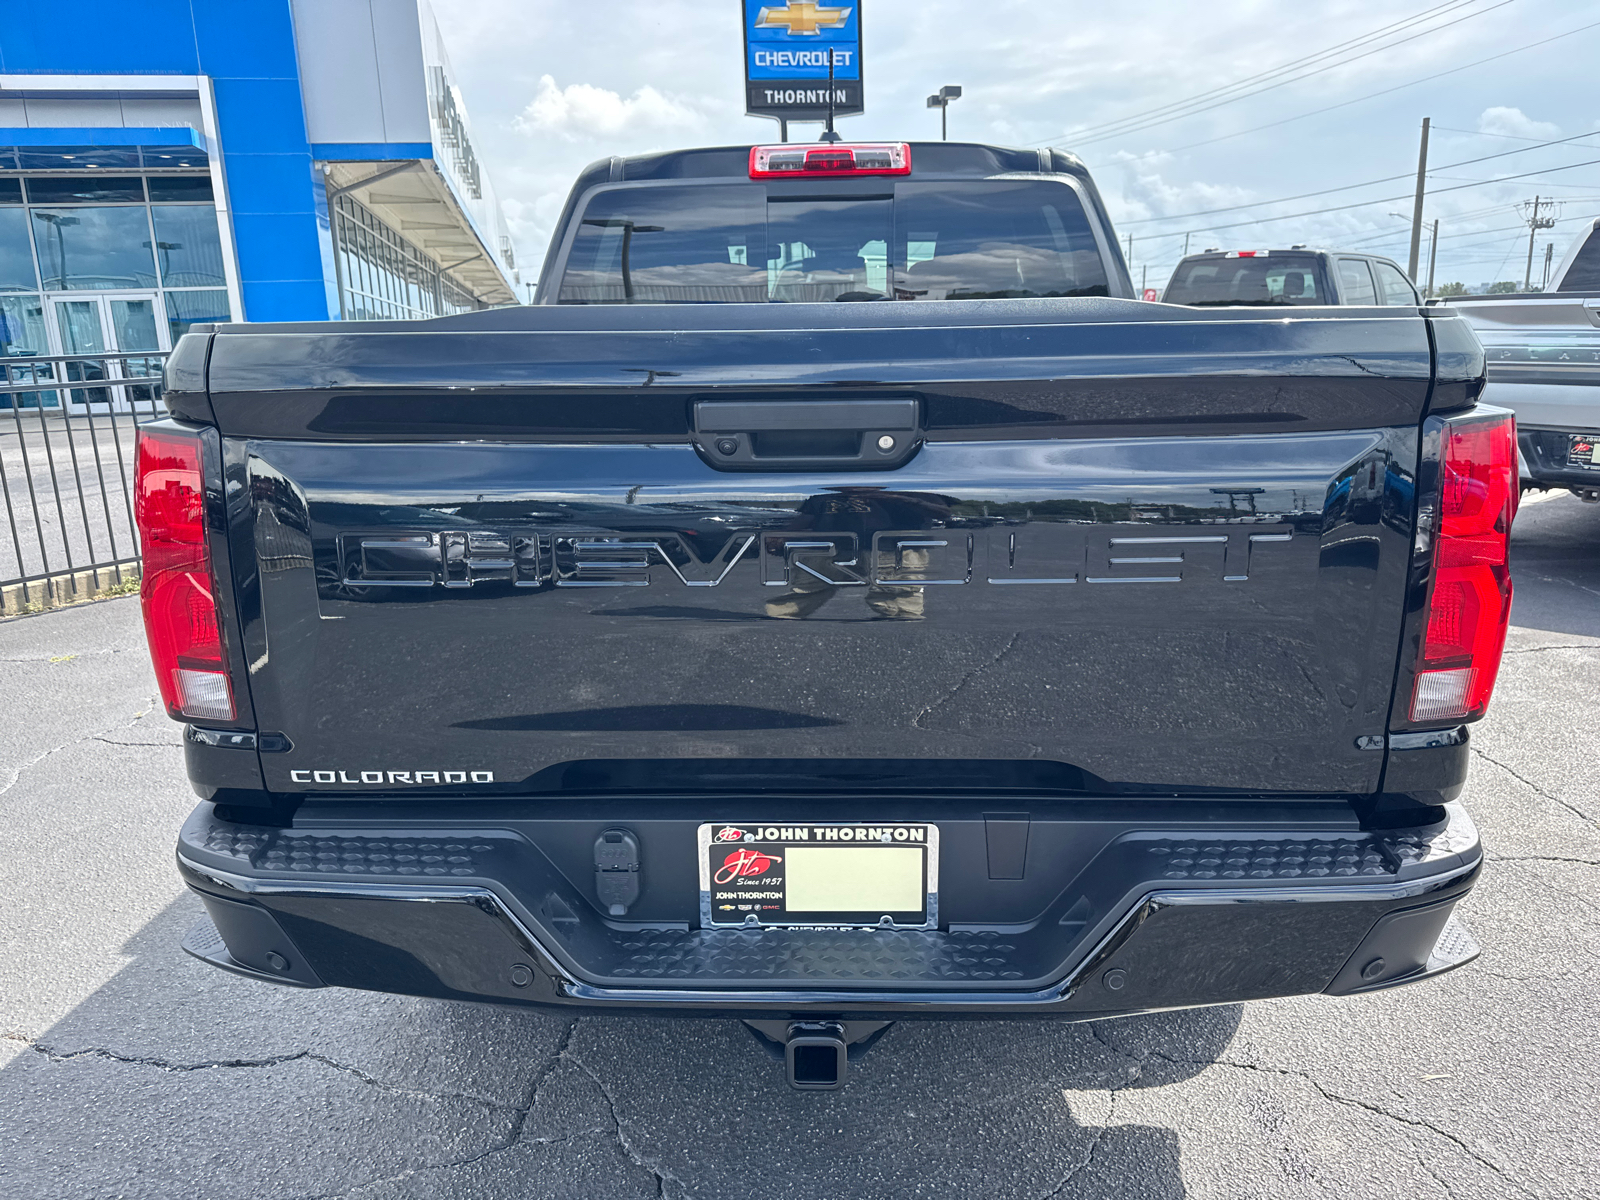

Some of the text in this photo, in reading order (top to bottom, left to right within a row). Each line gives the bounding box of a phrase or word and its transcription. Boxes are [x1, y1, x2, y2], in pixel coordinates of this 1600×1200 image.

[754, 51, 853, 66] CHEVROLET
[764, 89, 847, 103] THORNTON
[335, 523, 1296, 588] CHEVROLET
[290, 769, 494, 784] COLORADO
[755, 827, 924, 842] JOHN THORNTON
[736, 877, 783, 886] Since 1957
[715, 891, 783, 900] JOHN THORNTON
